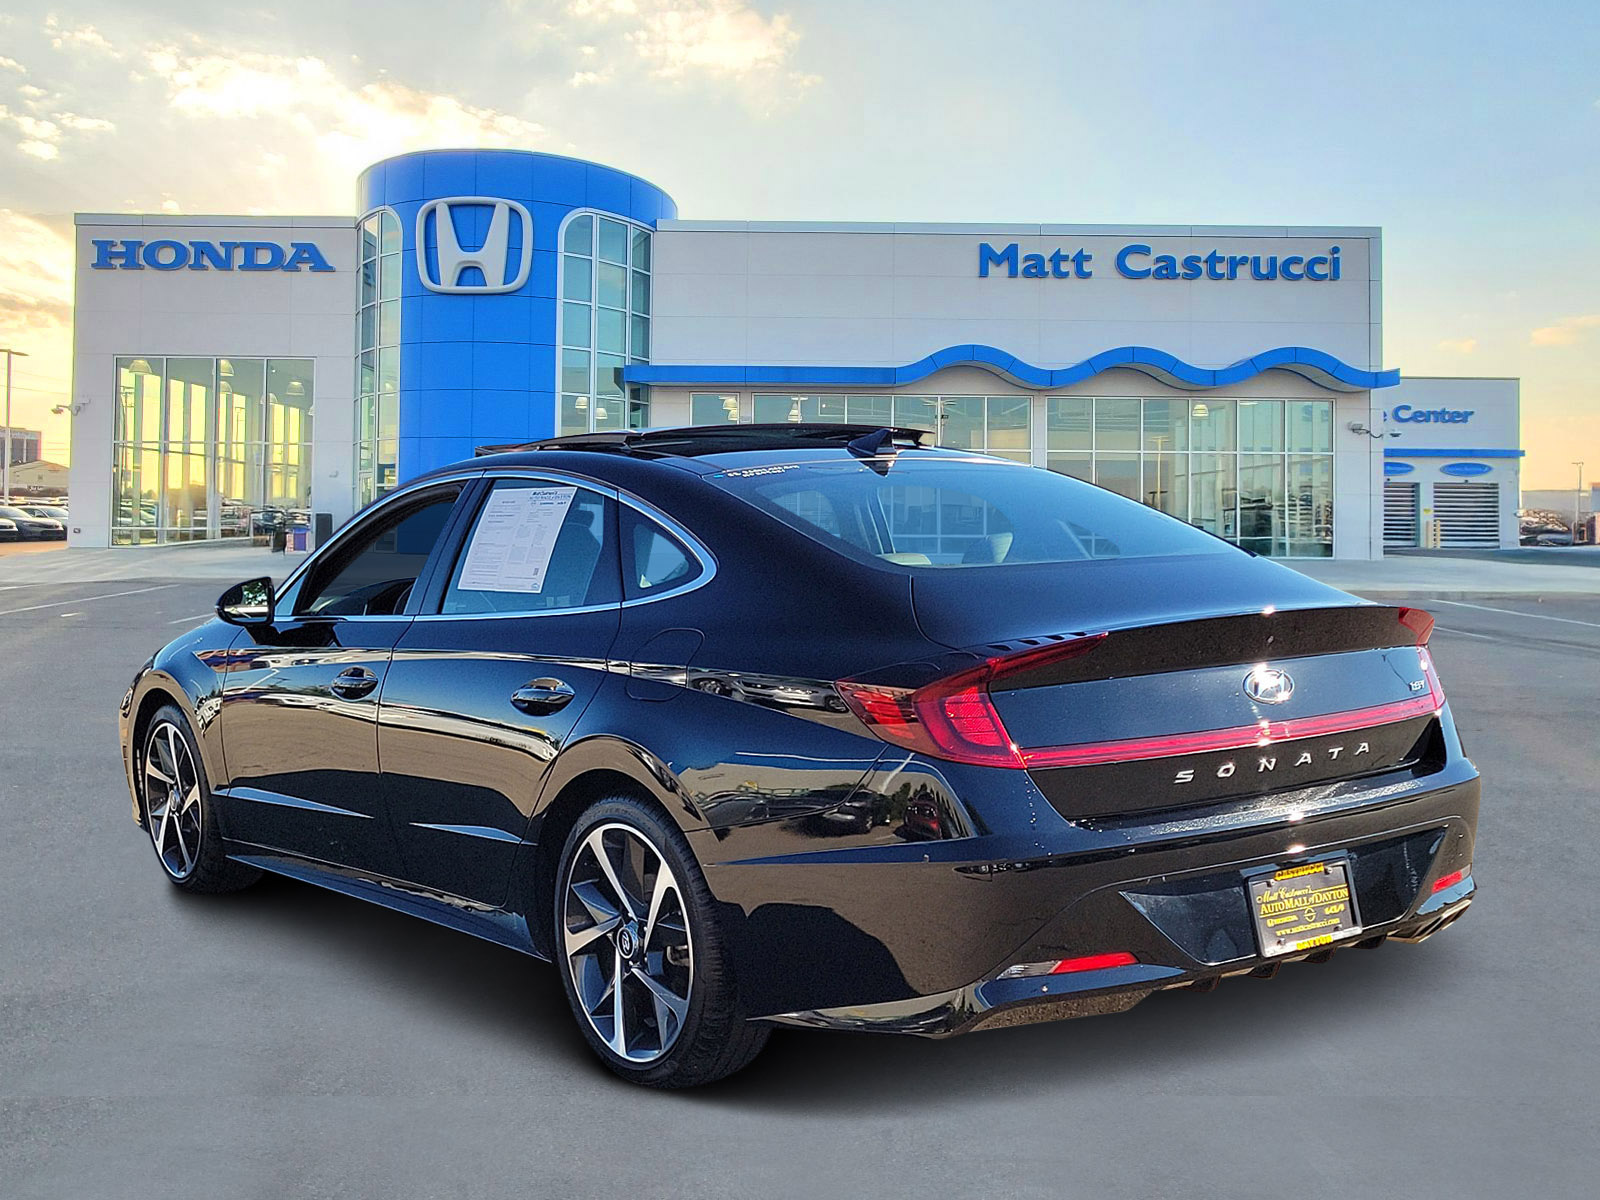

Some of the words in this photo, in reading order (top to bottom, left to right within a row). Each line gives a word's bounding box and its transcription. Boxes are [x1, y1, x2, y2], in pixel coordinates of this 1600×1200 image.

[91, 239, 336, 273] HONDA
[978, 242, 1094, 279] Matt
[1114, 244, 1342, 281] Castrucci
[1391, 404, 1475, 424] Center
[1173, 741, 1370, 784] SONATA
[1313, 888, 1349, 905] DAYTON
